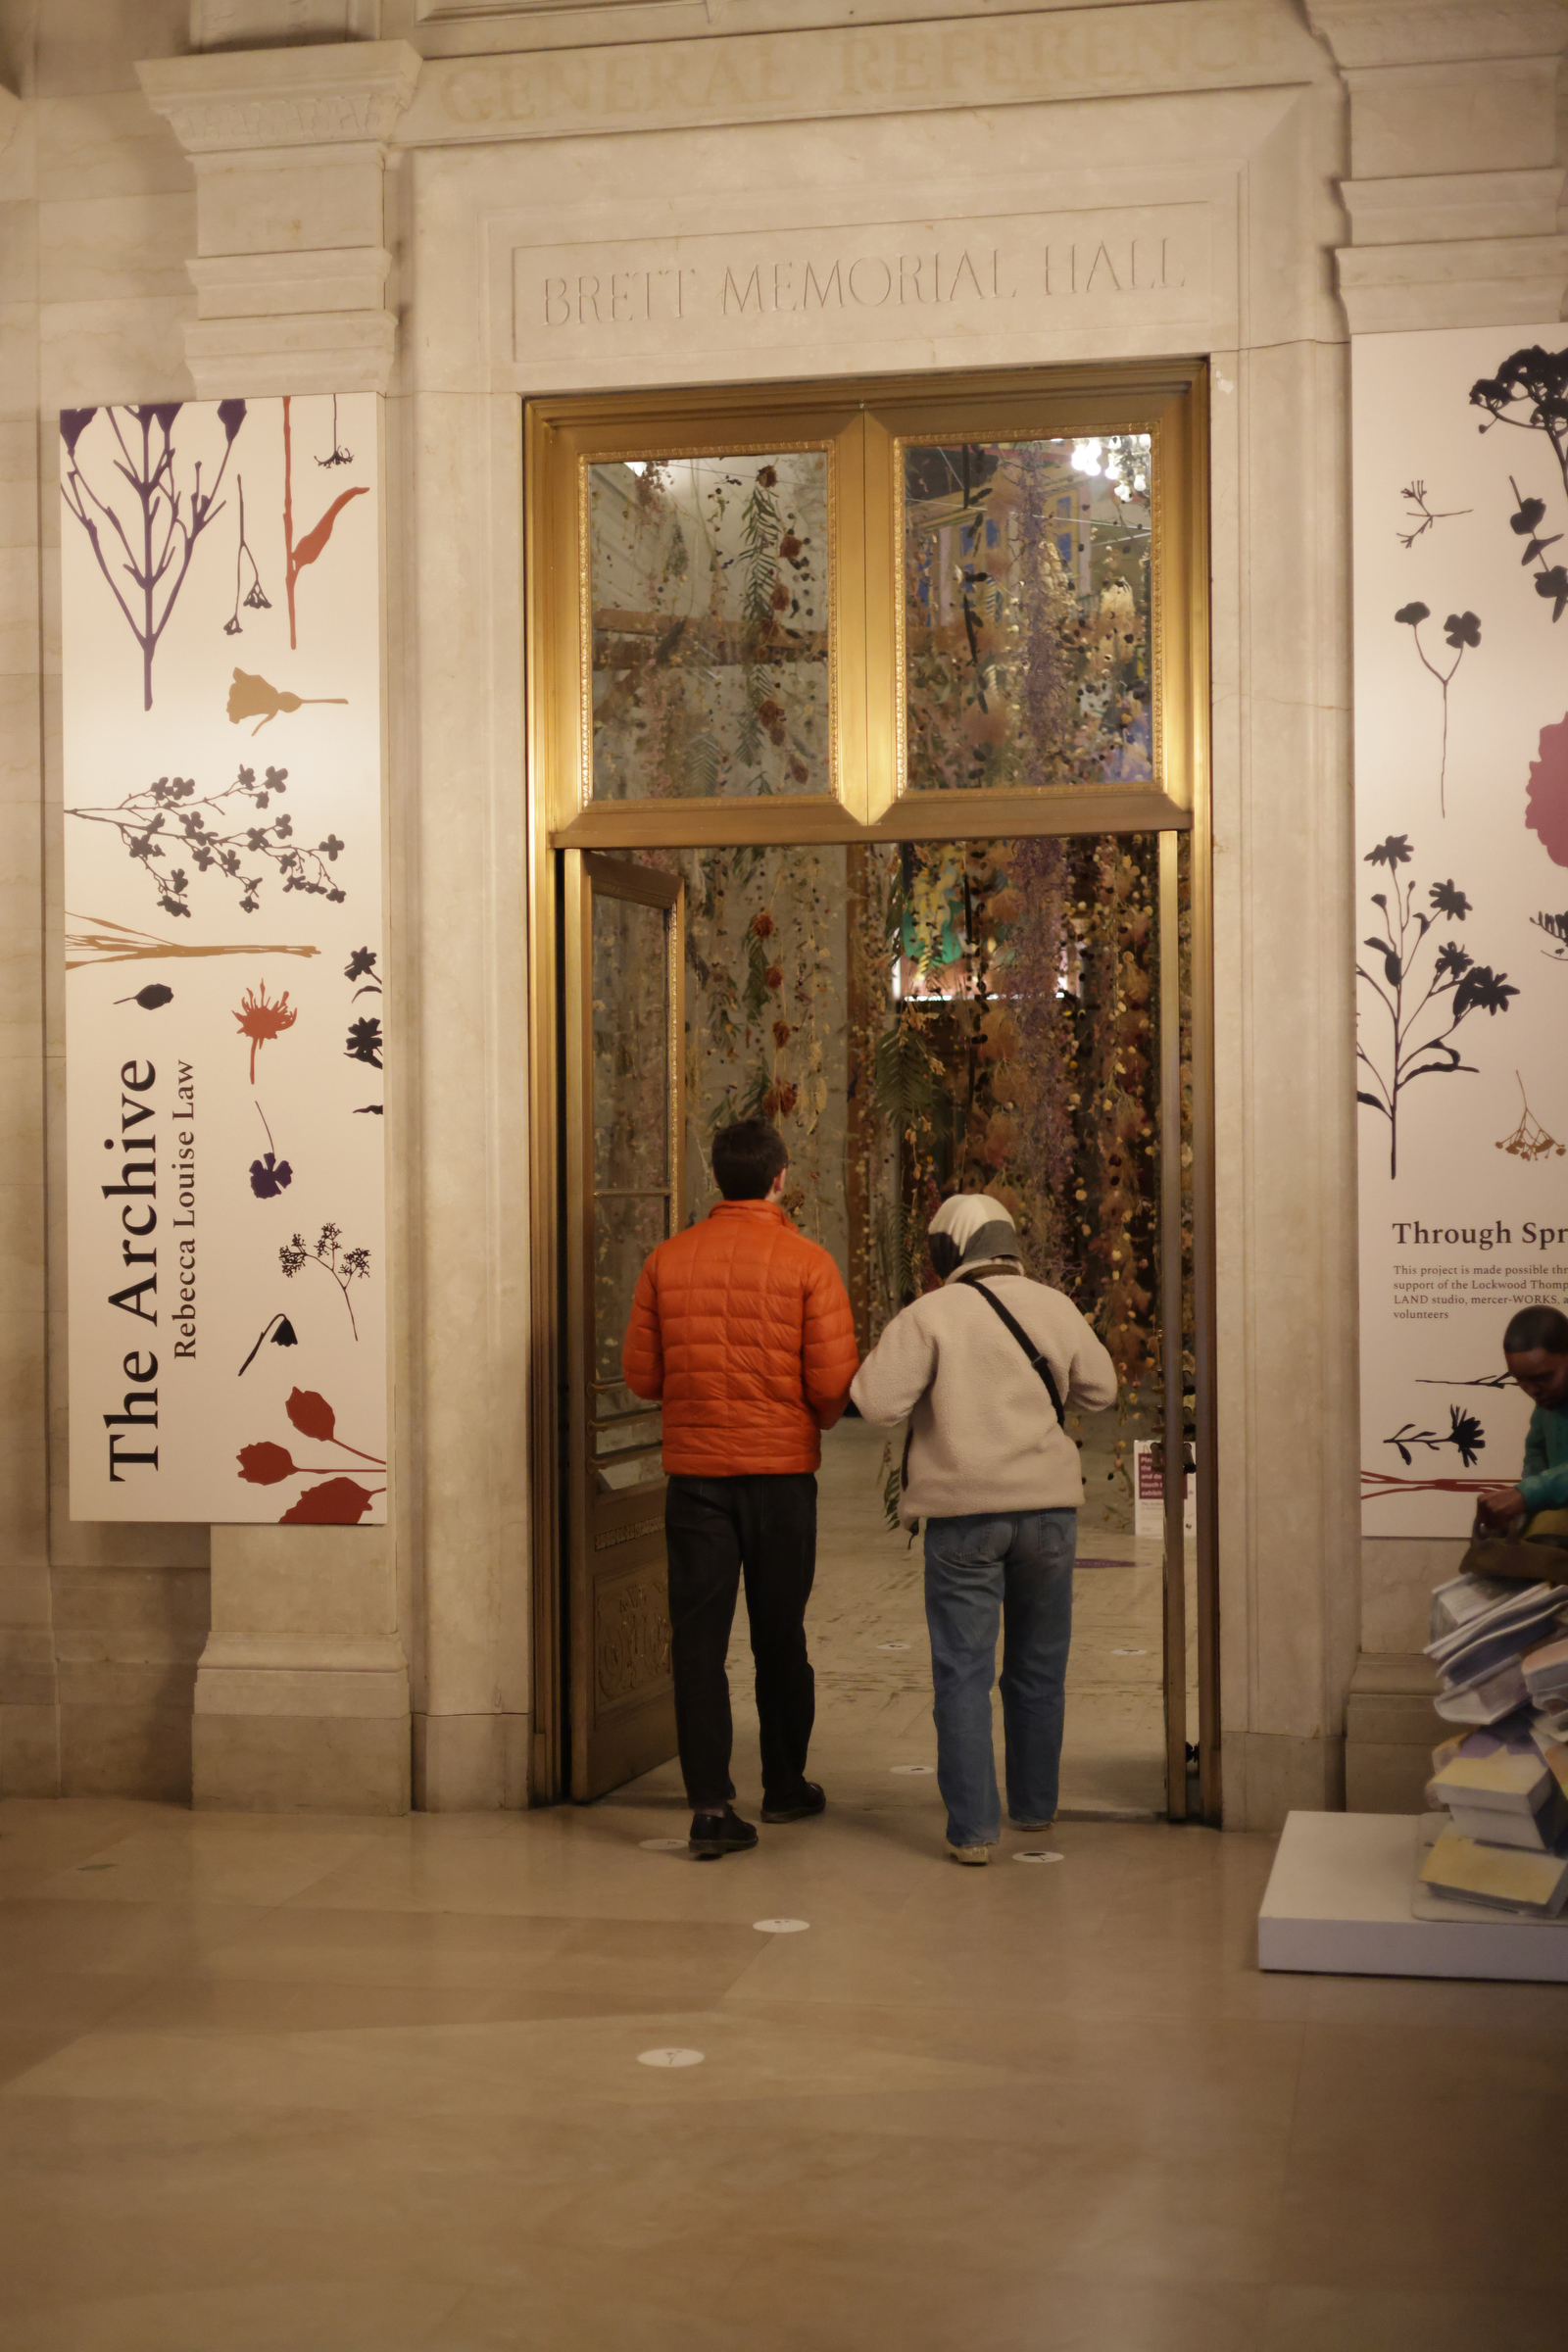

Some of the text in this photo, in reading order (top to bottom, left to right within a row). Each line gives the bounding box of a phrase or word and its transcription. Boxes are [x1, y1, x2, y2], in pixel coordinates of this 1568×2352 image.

[442, 7, 1285, 124] GENERAL REFERENCE
[541, 237, 1186, 327] BRETT MEMORIAL HALL
[171, 1059, 196, 1360] Rebecca Louise Law
[1392, 1220, 1568, 1250] Through Spr
[100, 1058, 159, 1485] The Archive
[1394, 1264, 1568, 1277] This project is made possible thr
[1393, 1279, 1568, 1293] support of the Lockwood Thomp
[1394, 1295, 1429, 1304] LAND
[1431, 1294, 1468, 1305] studio,
[1471, 1294, 1561, 1305] mercer-WORKS,
[1393, 1308, 1449, 1319] volunteers
